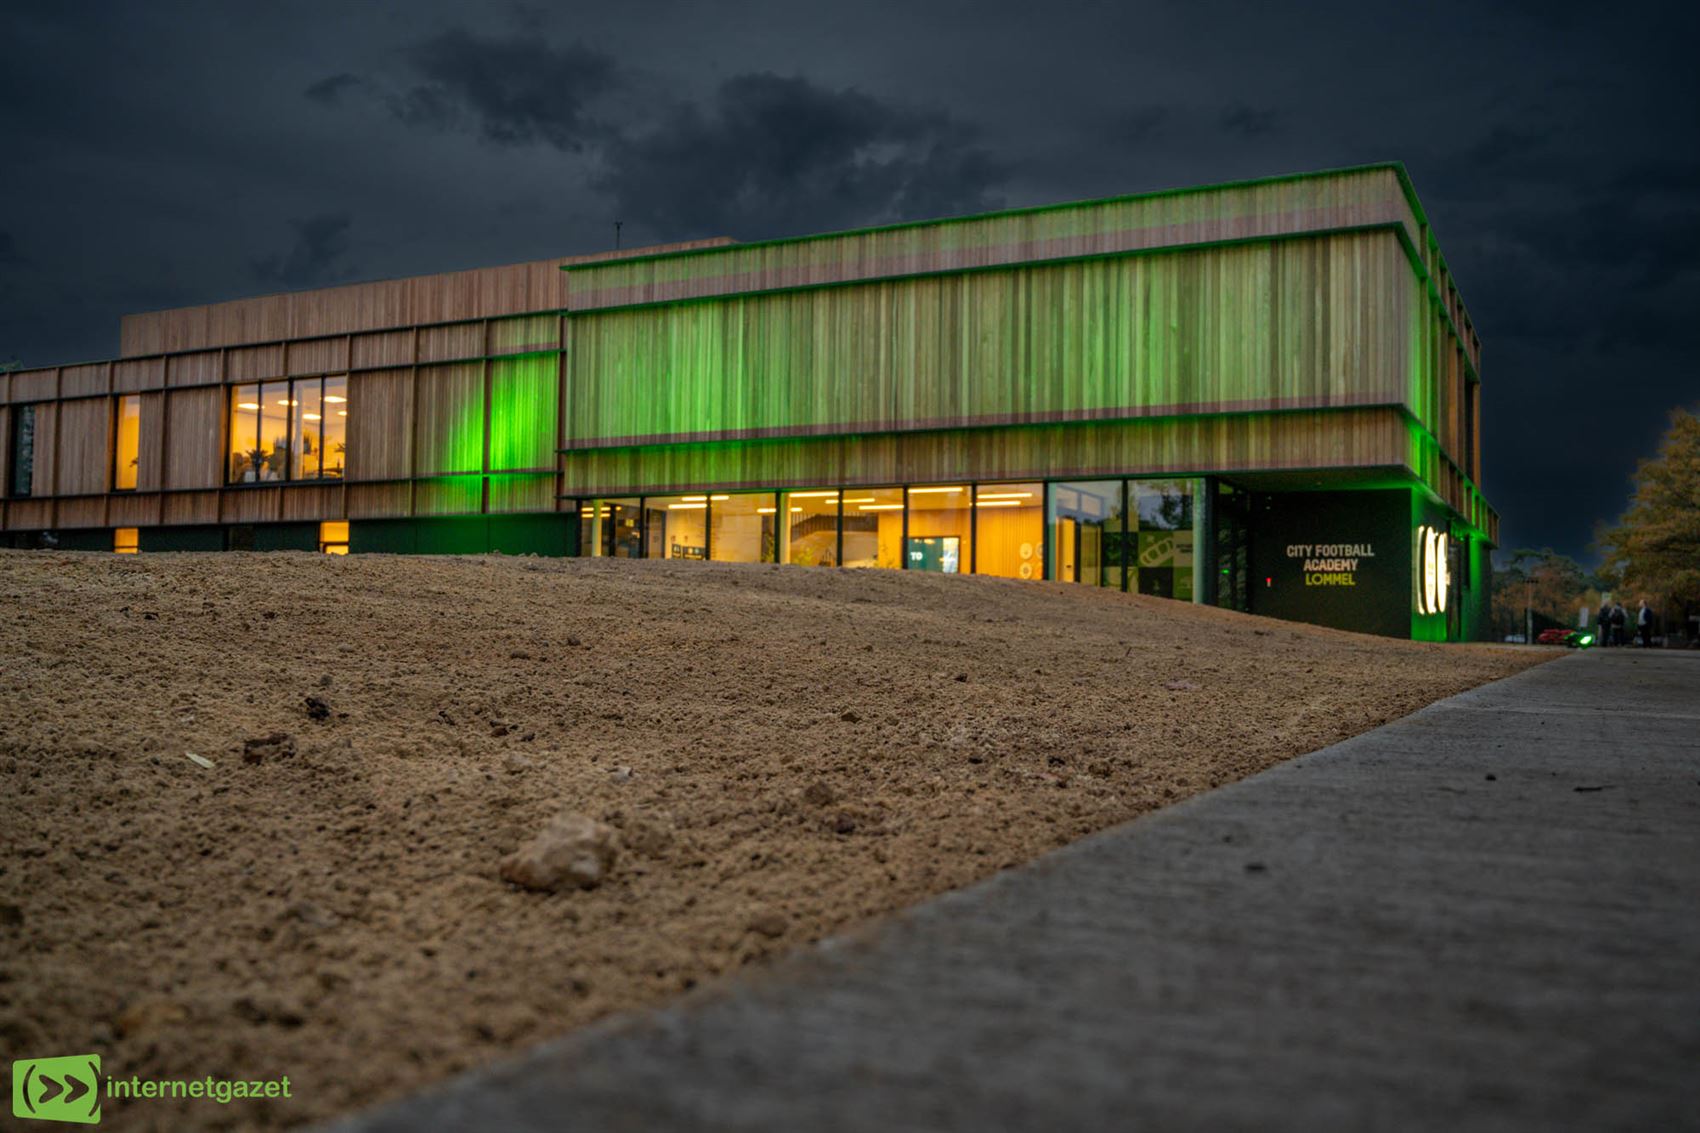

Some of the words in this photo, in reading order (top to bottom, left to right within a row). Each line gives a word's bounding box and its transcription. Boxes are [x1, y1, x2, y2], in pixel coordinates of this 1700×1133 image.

[1286, 544, 1313, 557] CITY
[1315, 543, 1375, 557] FOOTBALL
[1303, 558, 1359, 571] ACADEMY
[1305, 573, 1356, 586] LOMMEL
